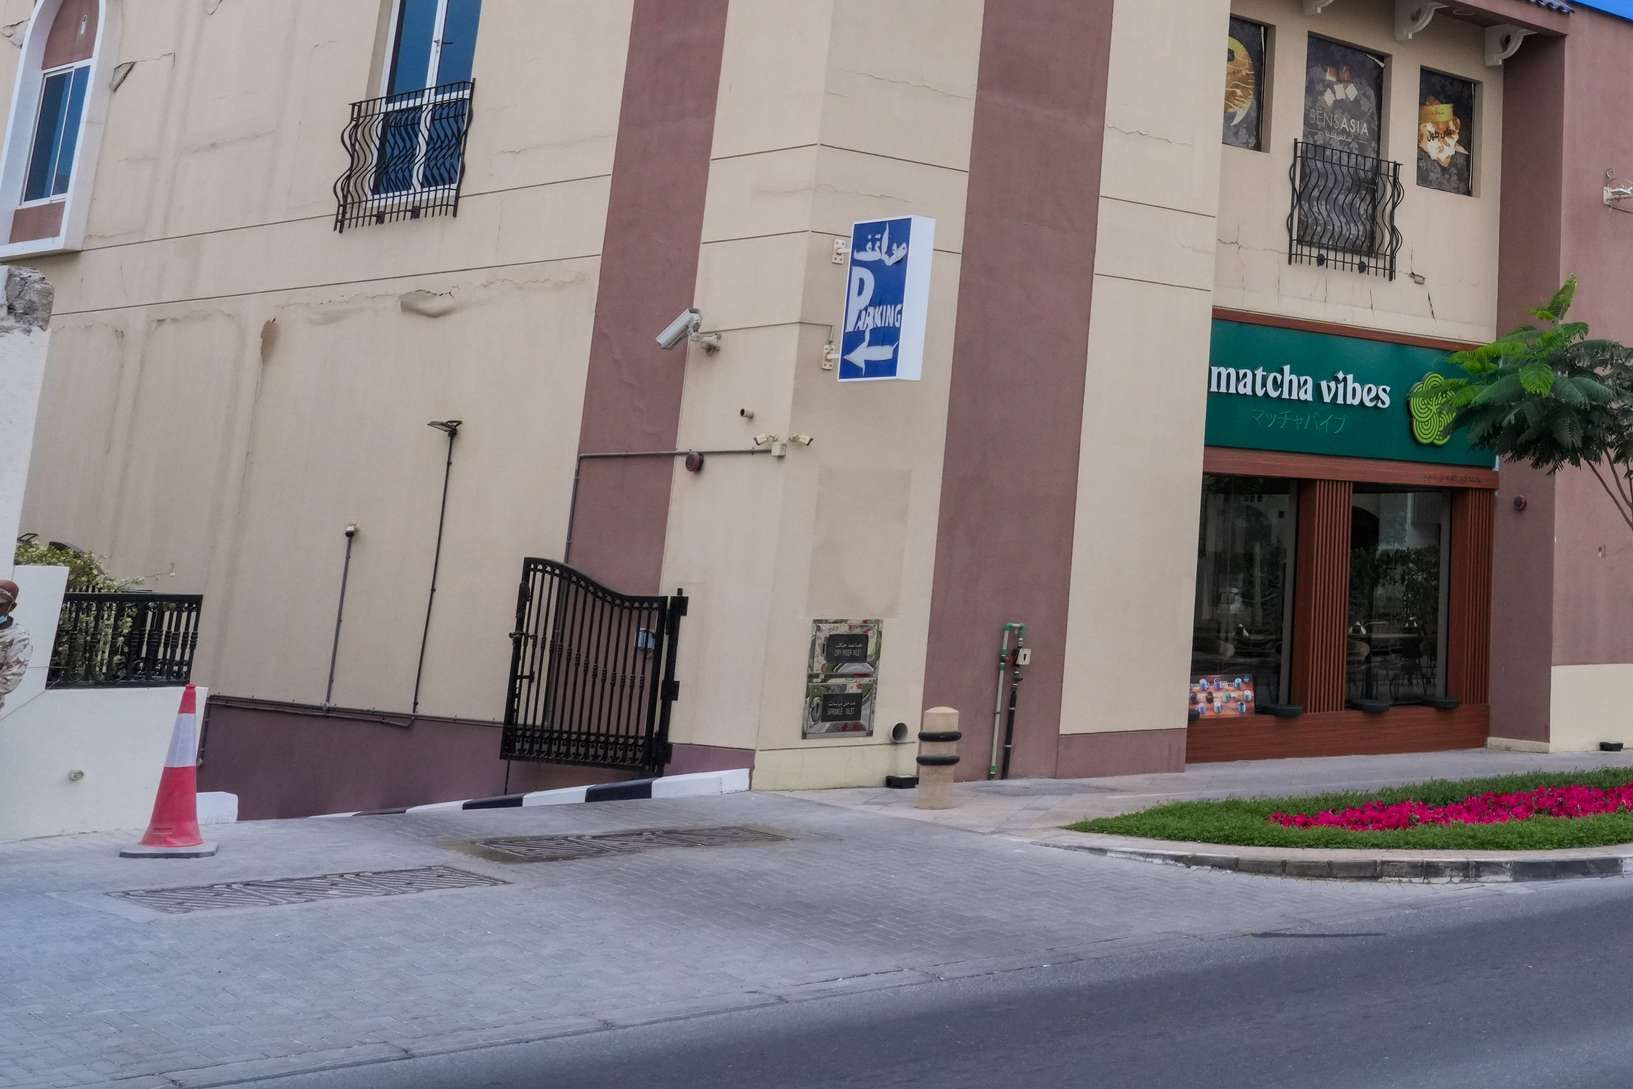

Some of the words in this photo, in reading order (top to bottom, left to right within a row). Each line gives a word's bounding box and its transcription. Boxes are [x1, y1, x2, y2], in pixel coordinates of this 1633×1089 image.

[854, 222, 907, 266] مواقف
[1209, 365, 1313, 402] matcha
[1320, 370, 1391, 409] vibes
